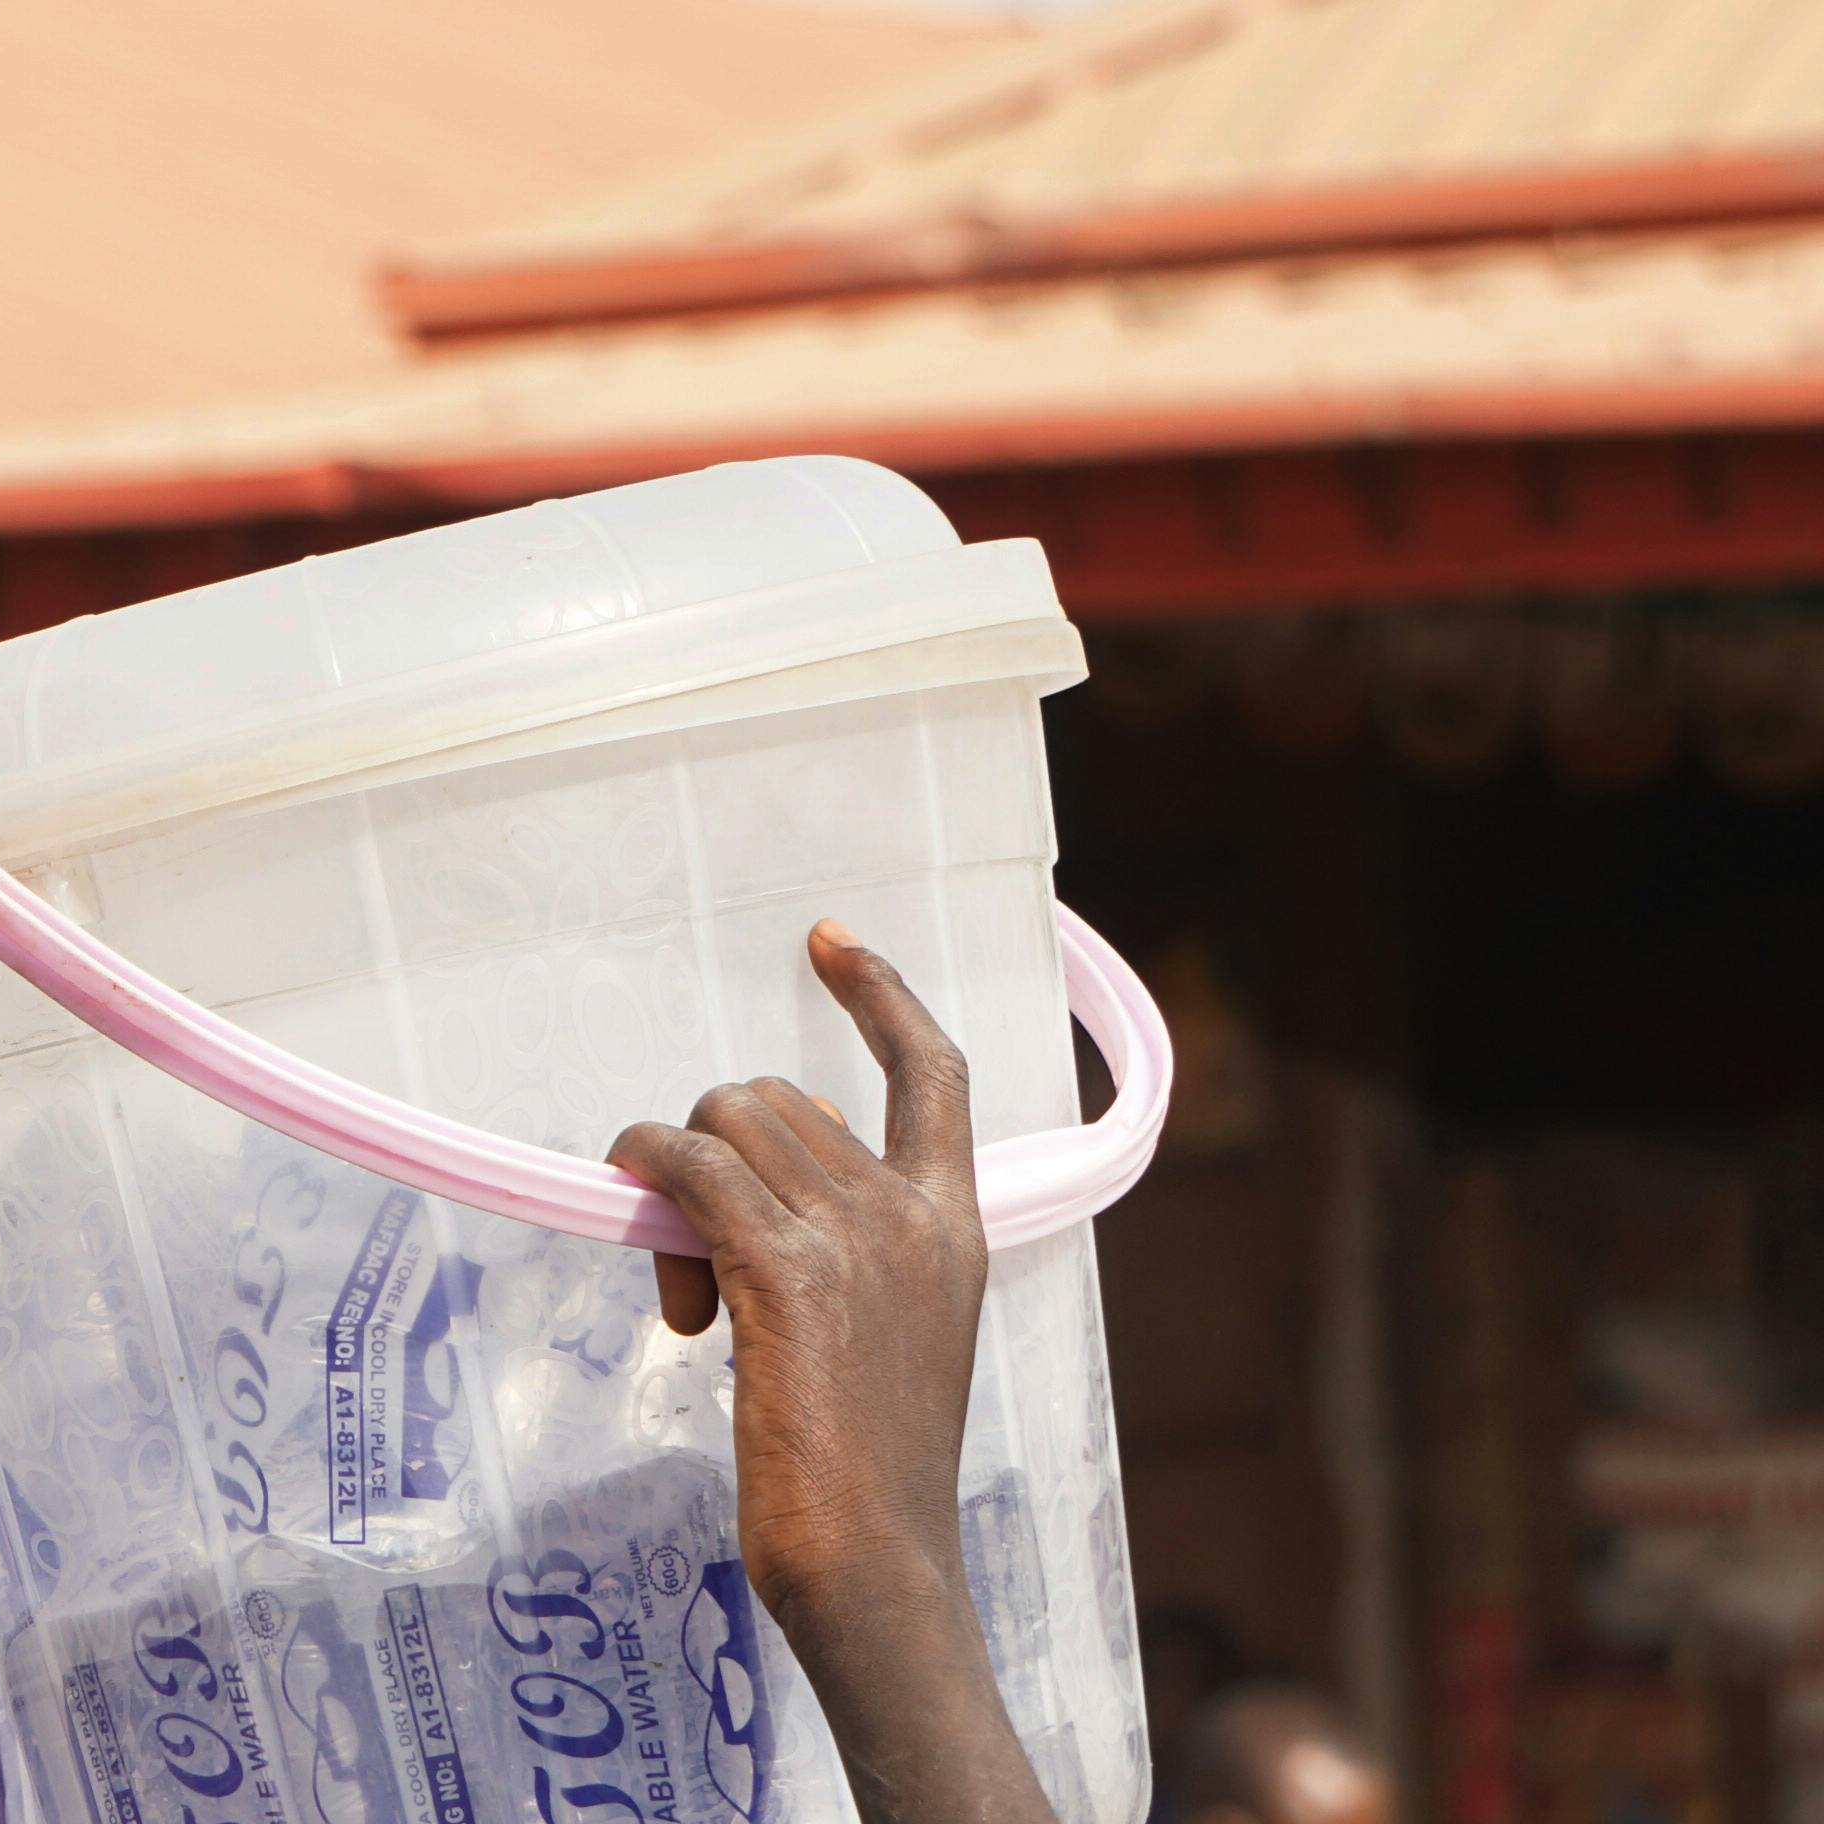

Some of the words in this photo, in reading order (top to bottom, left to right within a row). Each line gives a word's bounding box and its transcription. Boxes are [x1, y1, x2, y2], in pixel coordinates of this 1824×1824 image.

[358, 1199, 408, 1287] NAFDAC
[384, 1241, 422, 1308] STORE
[333, 1325, 358, 1367] NO:
[369, 1329, 388, 1382] COOL
[370, 1387, 386, 1428] DRY
[334, 1385, 358, 1515] A1-8312L
[370, 1431, 387, 1500] PLACE
[627, 1536, 648, 1592] VOLUME
[658, 1552, 679, 1589] 60cl
[640, 1595, 655, 1620] NET
[375, 1637, 401, 1707] PLACE
[400, 1614, 447, 1742] A1-8312L
[614, 1618, 664, 1734] WATER
[222, 1663, 270, 1773] WATER
[393, 1708, 413, 1749] DRY
[88, 1750, 107, 1784] DRY
[405, 1753, 428, 1806] COOL
[437, 1758, 462, 1803] NO:
